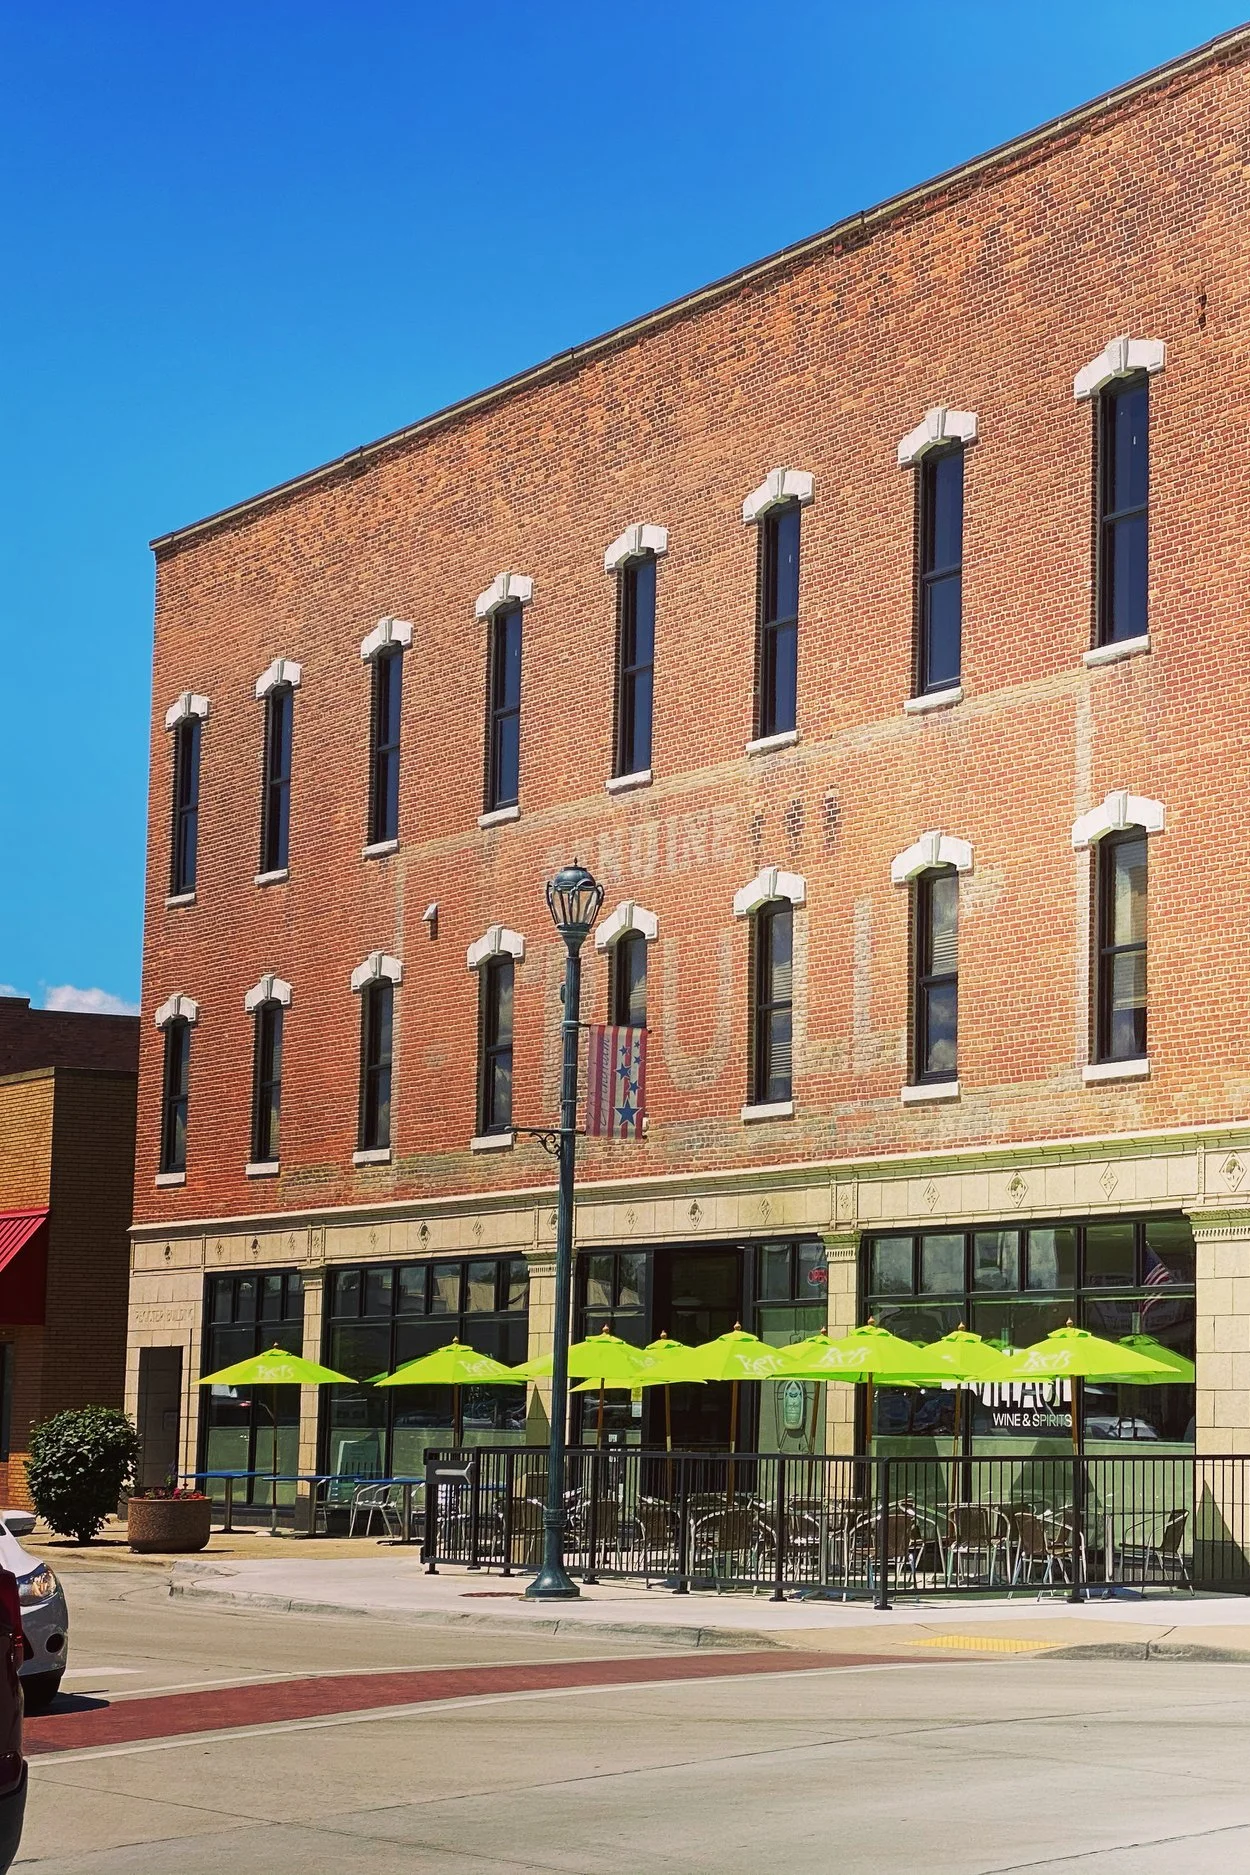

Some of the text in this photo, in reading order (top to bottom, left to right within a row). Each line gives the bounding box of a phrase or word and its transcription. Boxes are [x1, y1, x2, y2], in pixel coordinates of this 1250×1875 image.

[992, 1413, 1073, 1428] WINE & SPIRITS
